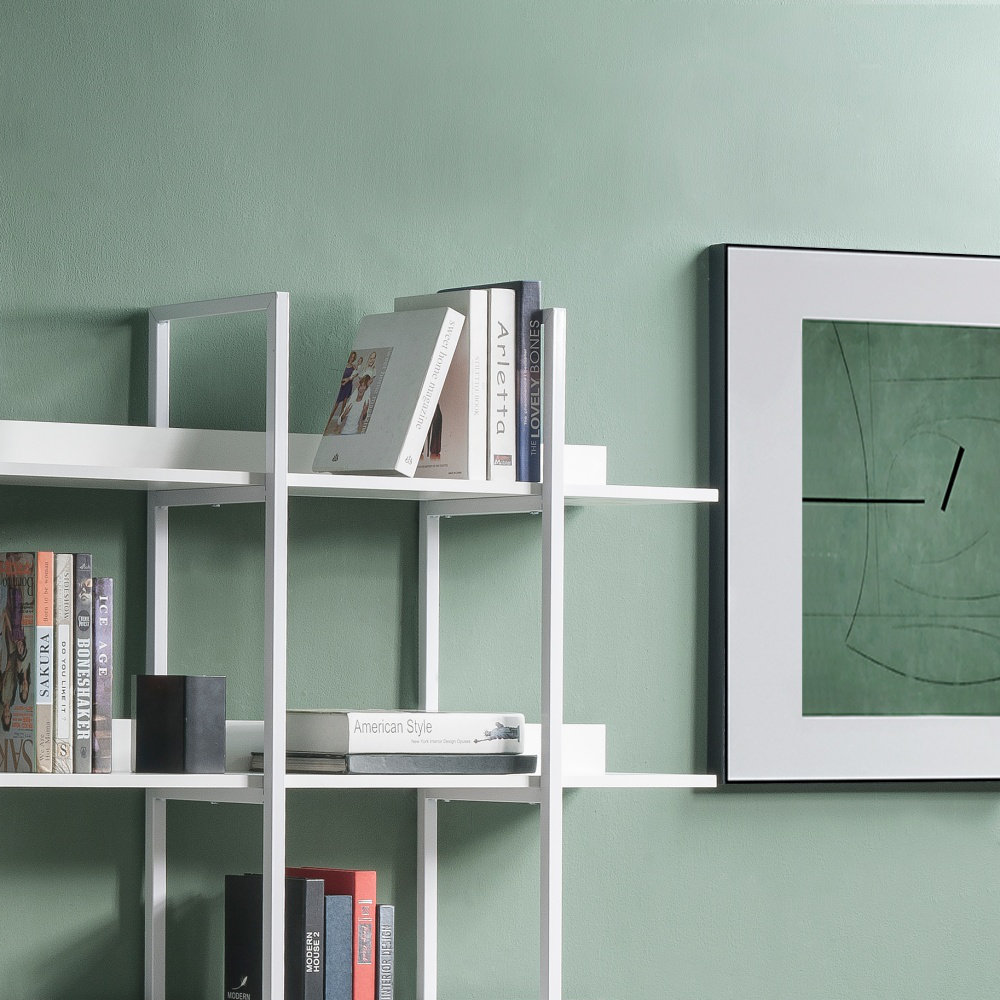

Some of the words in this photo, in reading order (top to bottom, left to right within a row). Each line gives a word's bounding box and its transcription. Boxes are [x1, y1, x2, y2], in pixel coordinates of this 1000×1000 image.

[431, 352, 447, 381] home
[529, 319, 541, 374] BONES
[496, 320, 509, 435] Arletta
[415, 381, 439, 431] magazine
[530, 374, 542, 438] LOVELY
[99, 596, 108, 626] ICE
[39, 633, 50, 697] SAKURA
[61, 641, 67, 656] DO
[98, 641, 108, 676] AGE
[77, 638, 91, 740] BONESHAKER
[354, 719, 403, 734] American
[407, 719, 432, 736] Style
[227, 991, 251, 1000] MODERN
[381, 959, 392, 1000] INTERIOR
